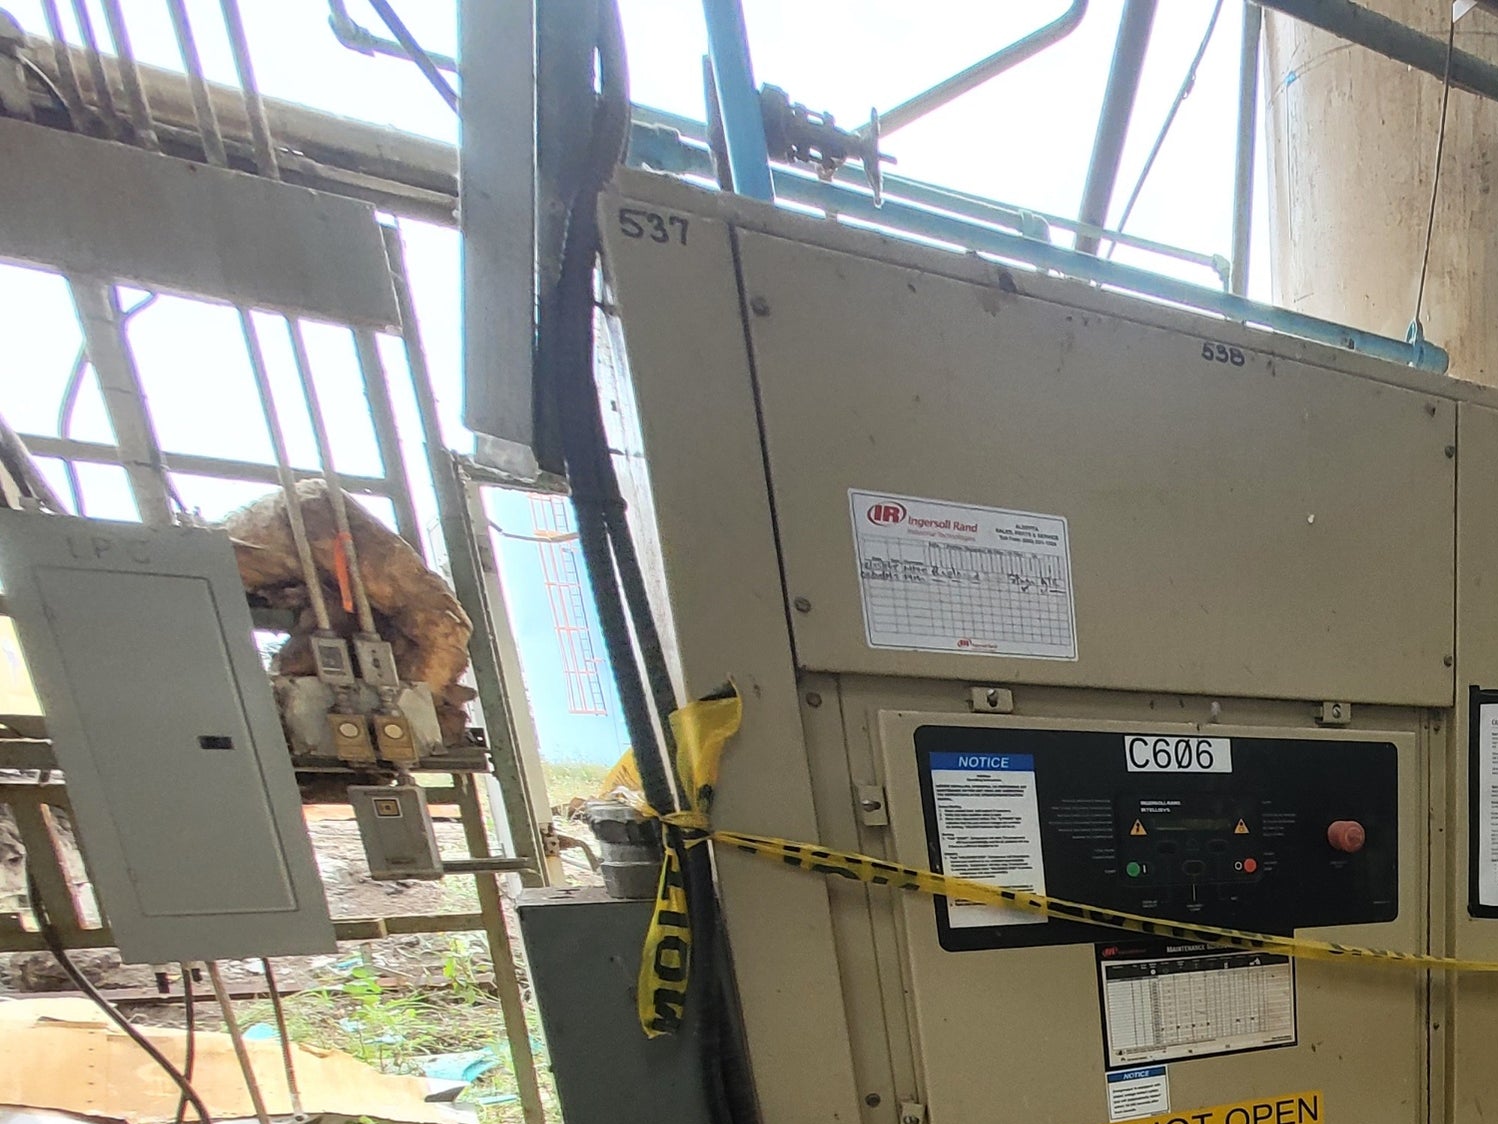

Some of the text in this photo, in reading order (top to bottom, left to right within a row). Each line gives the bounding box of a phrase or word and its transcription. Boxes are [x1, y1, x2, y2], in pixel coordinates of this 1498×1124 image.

[619, 208, 688, 246] 537
[908, 515, 951, 530] Ingersoll
[953, 521, 978, 533] Rand
[958, 756, 1009, 768] NOTICE
[1129, 737, 1214, 770] C606
[1123, 1070, 1149, 1080] NOTICE
